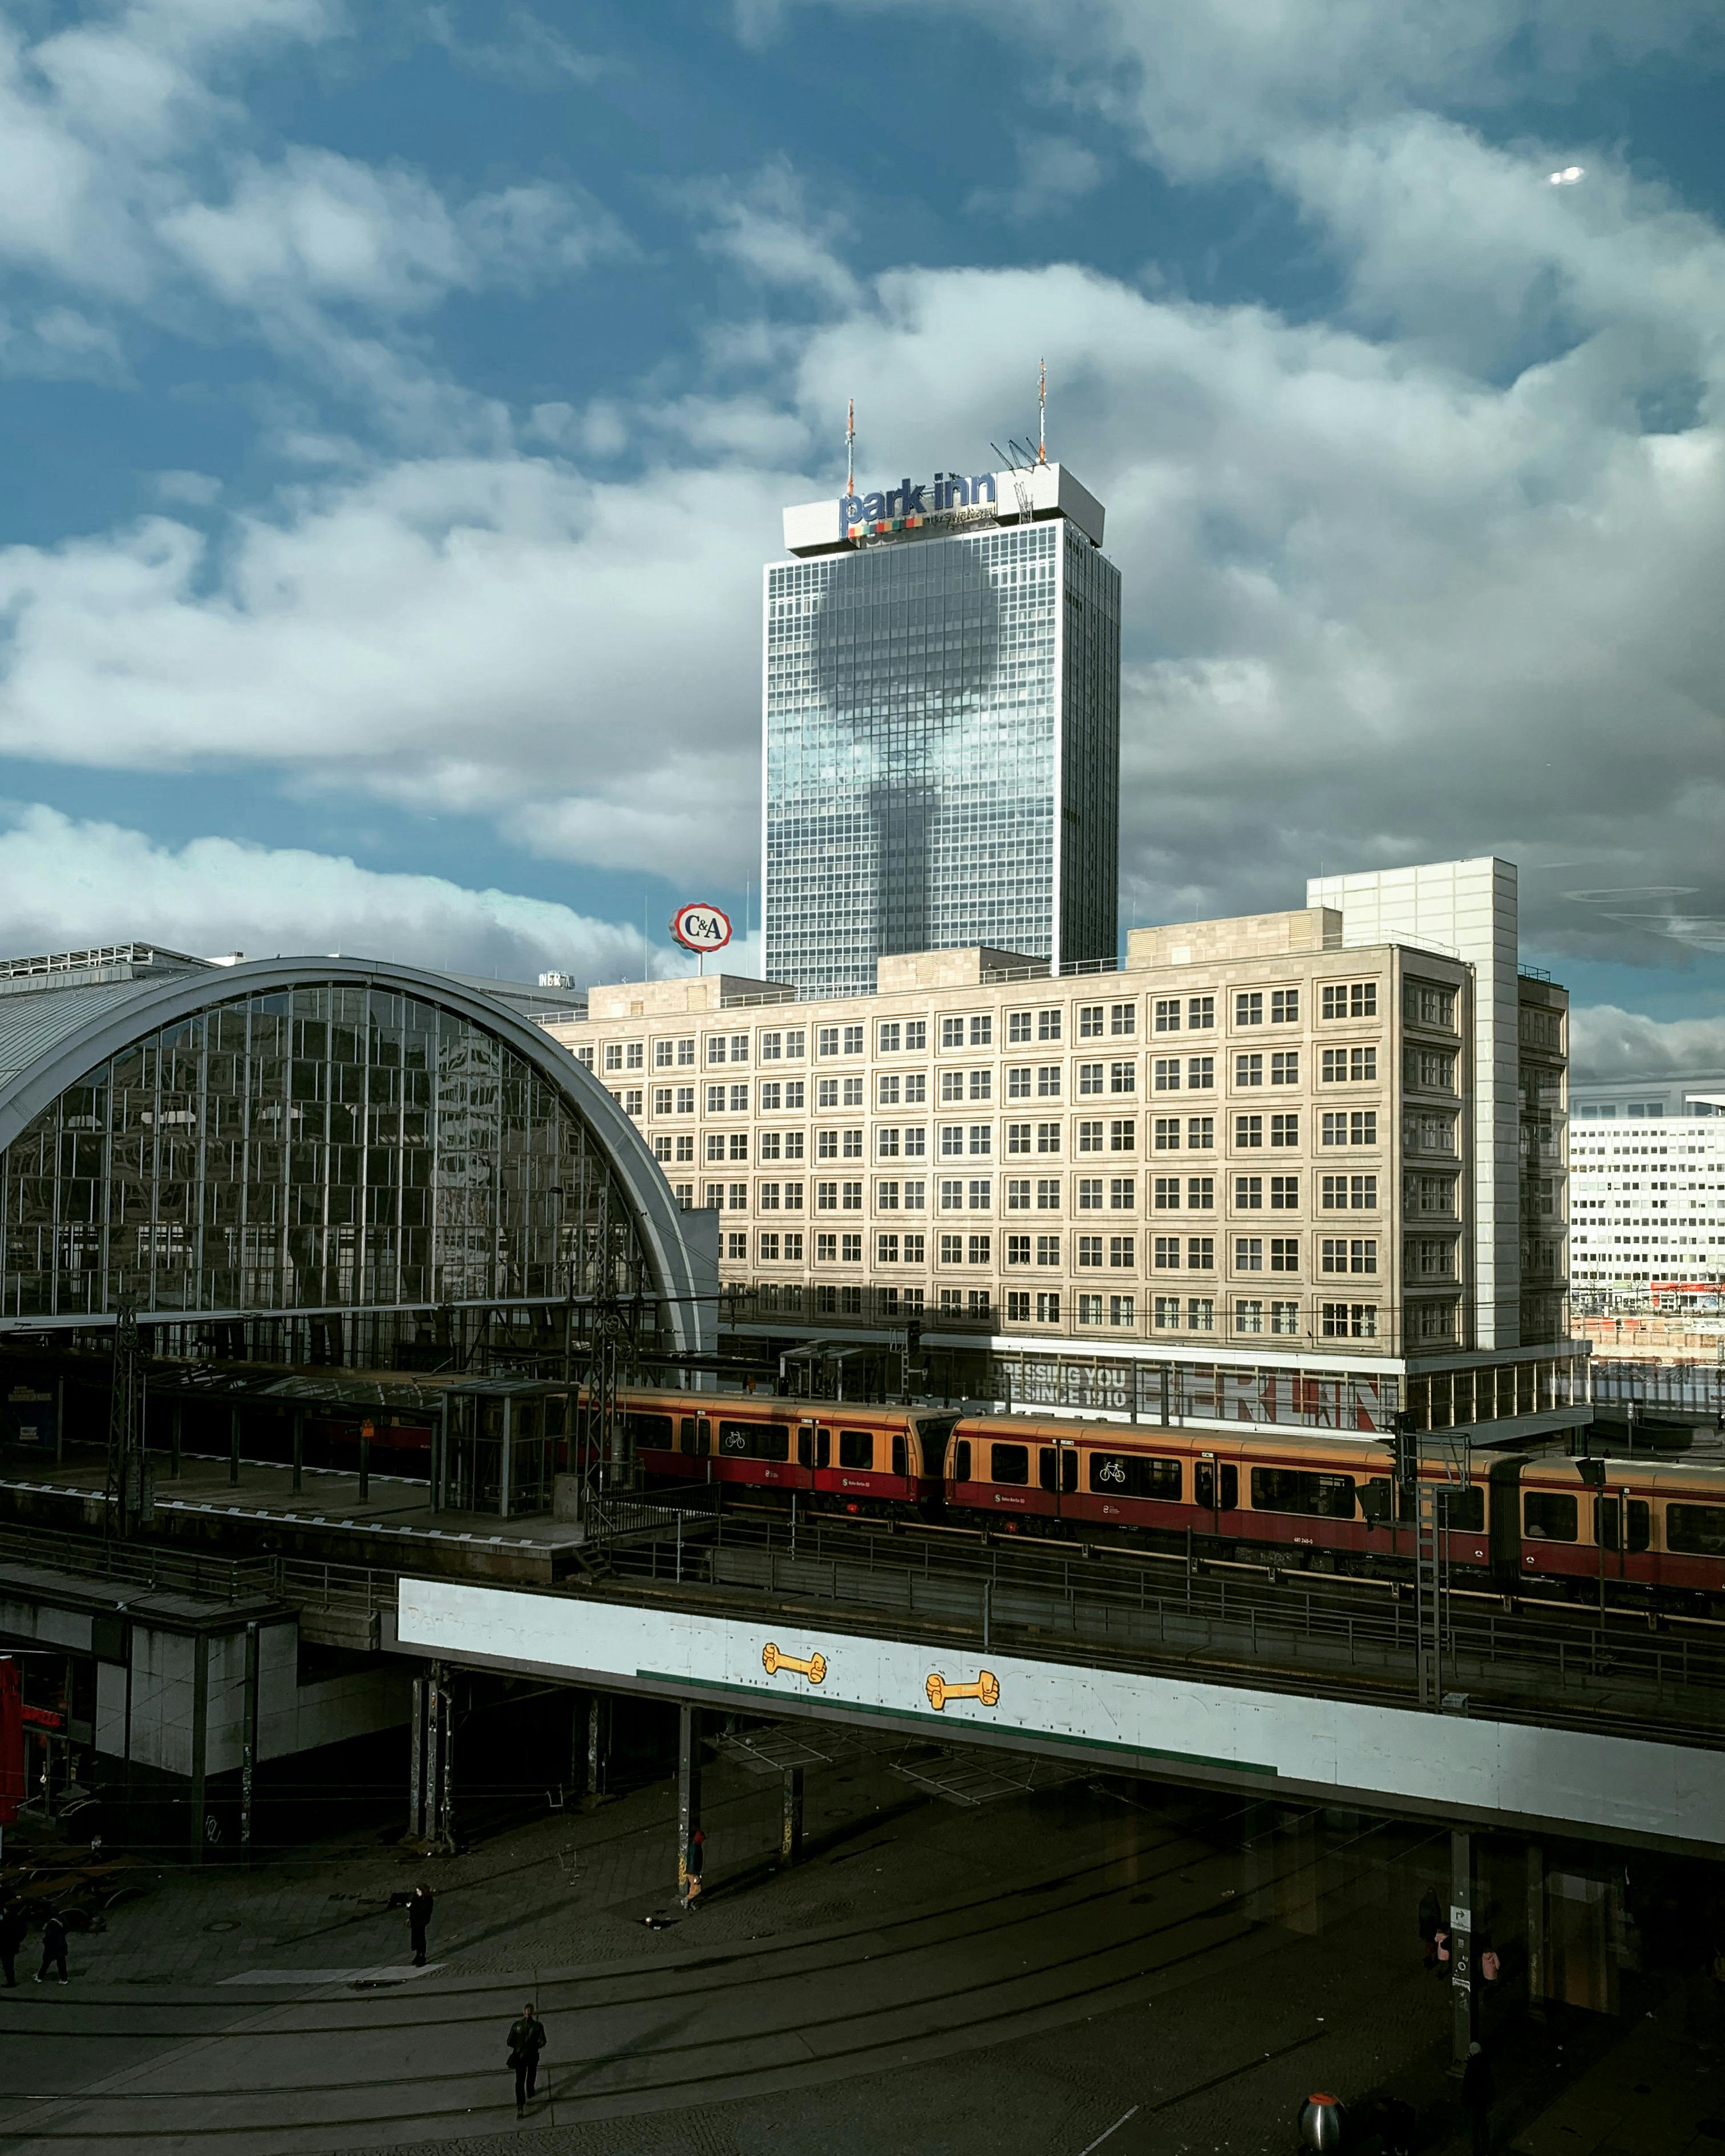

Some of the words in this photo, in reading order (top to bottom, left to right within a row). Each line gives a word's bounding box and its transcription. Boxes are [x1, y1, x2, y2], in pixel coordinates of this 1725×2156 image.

[839, 478, 926, 539] park
[934, 472, 995, 510] inn
[685, 915, 723, 939] C&A
[990, 1361, 1080, 1383] DRESSING
[1084, 1367, 1126, 1387] YOU
[974, 1379, 1021, 1399] HERE
[1025, 1383, 1079, 1403] SINCE
[1084, 1388, 1126, 1407] 1910
